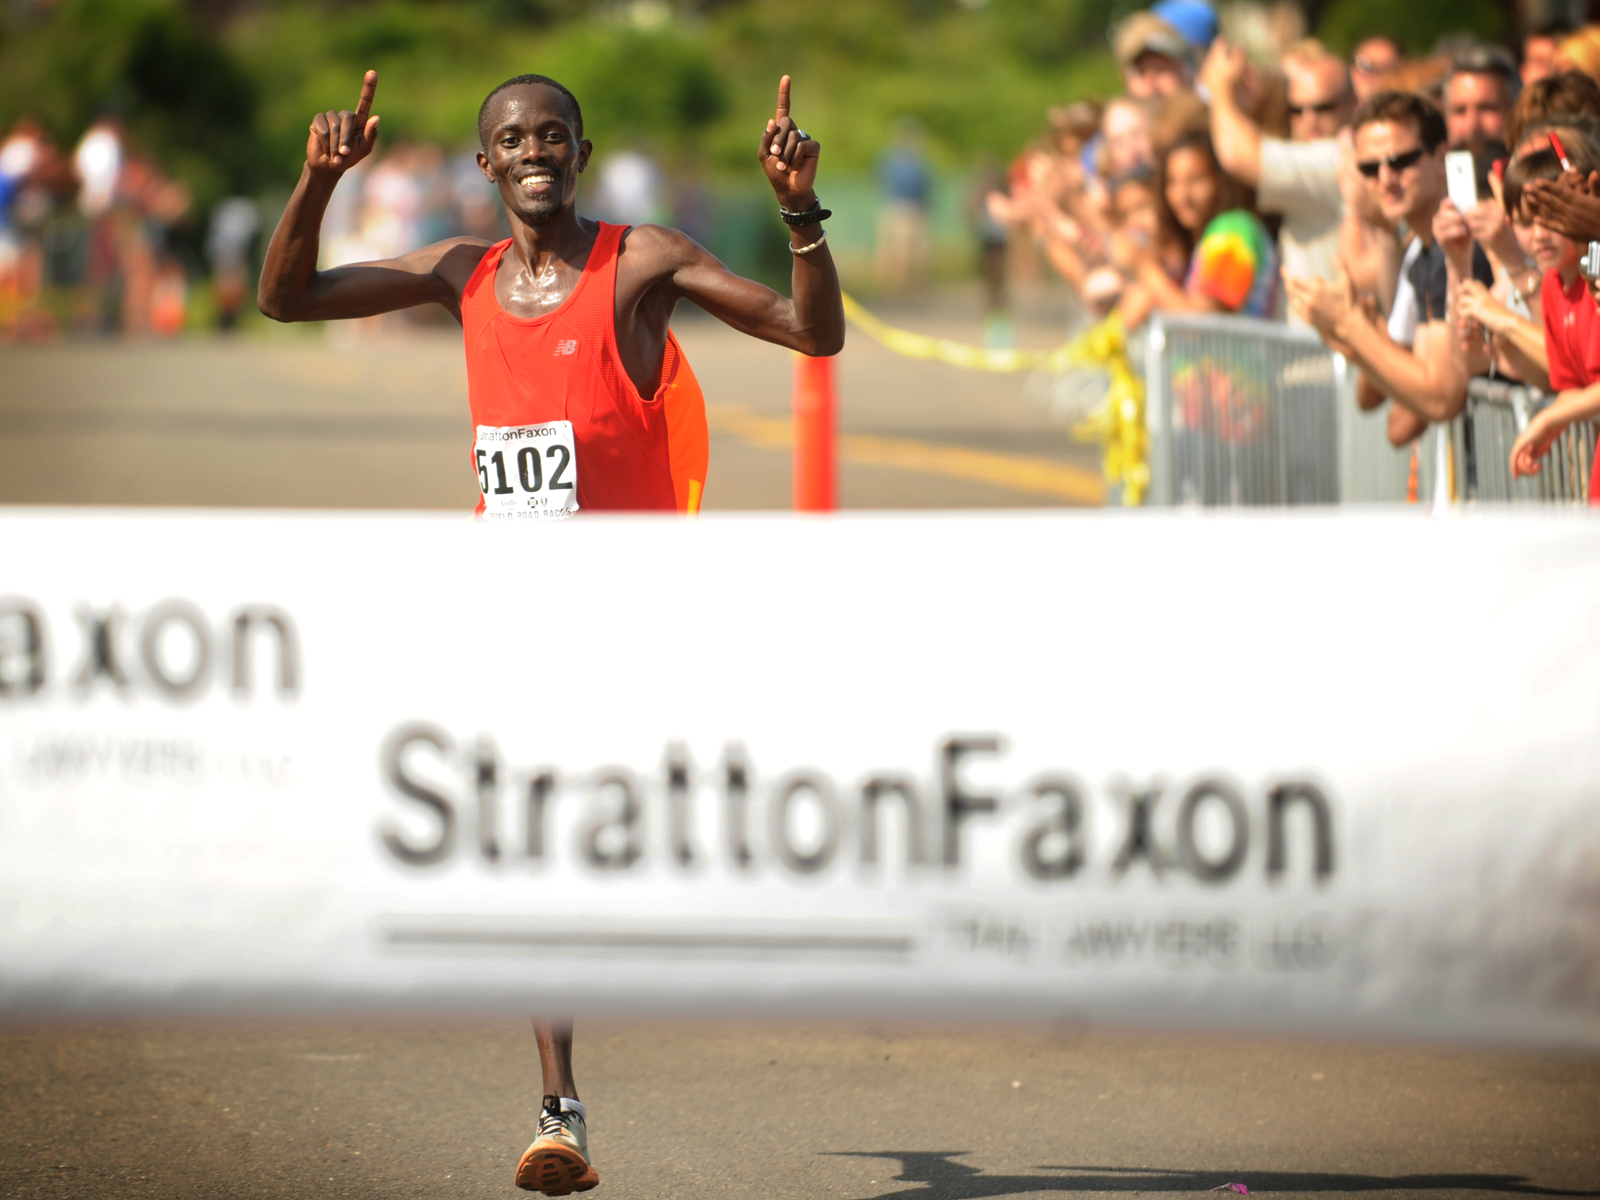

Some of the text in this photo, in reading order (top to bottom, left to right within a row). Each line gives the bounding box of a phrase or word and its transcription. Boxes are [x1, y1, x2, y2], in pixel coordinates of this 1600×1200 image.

[476, 444, 573, 495] 5102
[517, 509, 539, 520] ROAD
[376, 720, 1338, 884] StrattonFaxon
